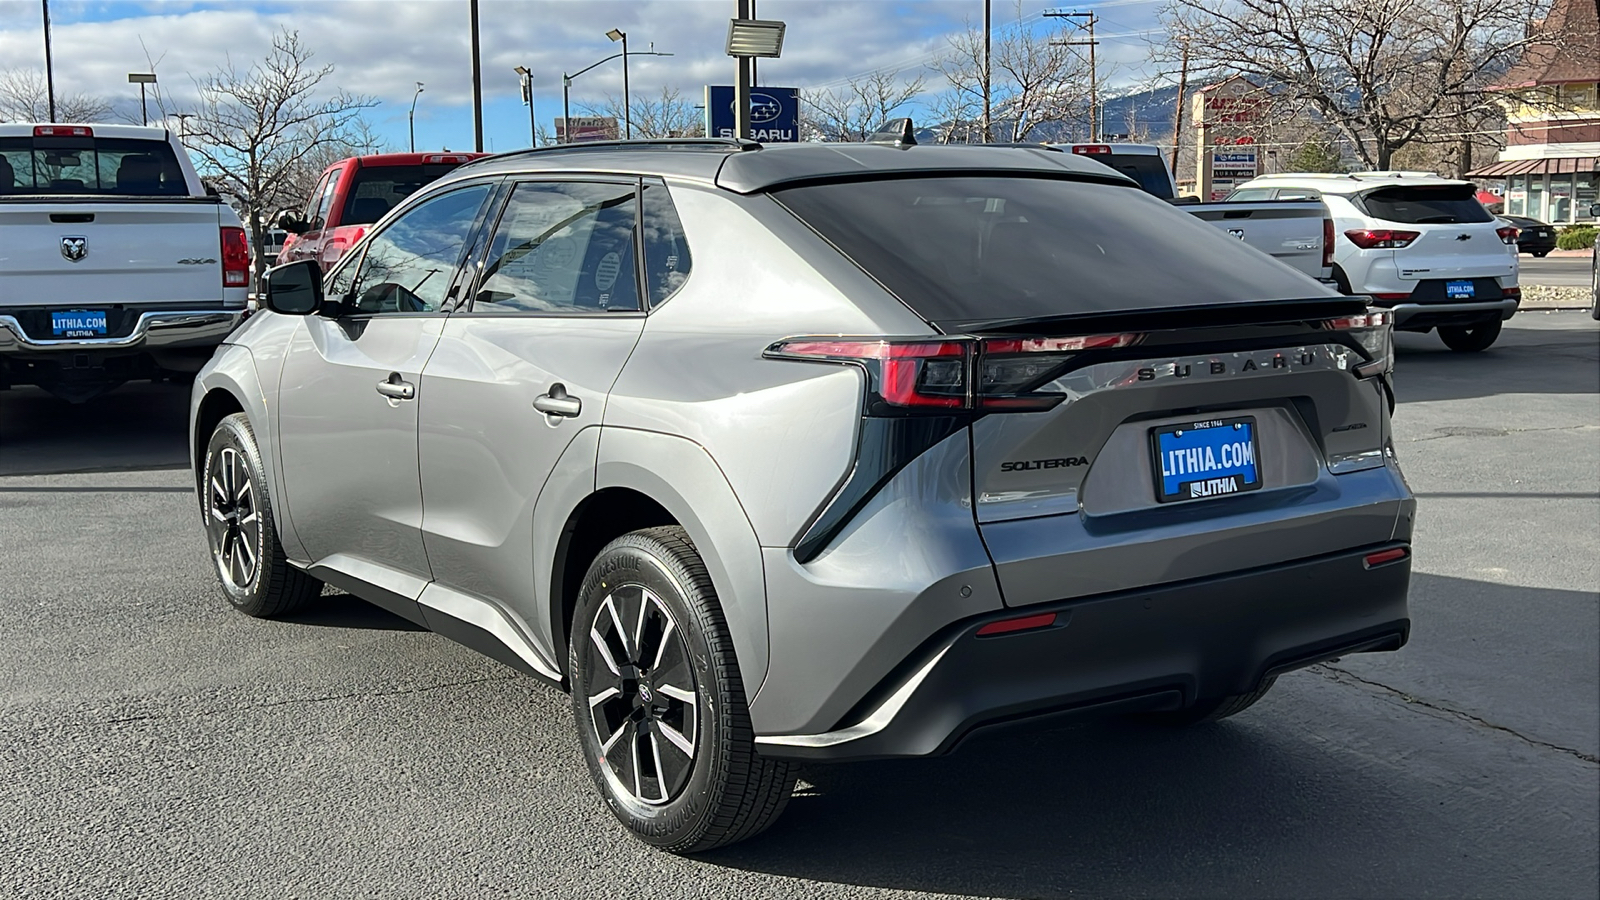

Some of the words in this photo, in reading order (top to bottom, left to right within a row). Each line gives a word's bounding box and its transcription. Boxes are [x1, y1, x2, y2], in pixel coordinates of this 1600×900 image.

[52, 317, 107, 329] LITHIA.COM
[1138, 353, 1314, 381] SUBARU
[1193, 421, 1209, 429] SINCE
[1001, 456, 1089, 472] SOLTERRA
[1160, 441, 1253, 476] LITHIA.COM
[1201, 477, 1237, 496] LITHIA
[582, 555, 642, 605] BRIDGESTONE
